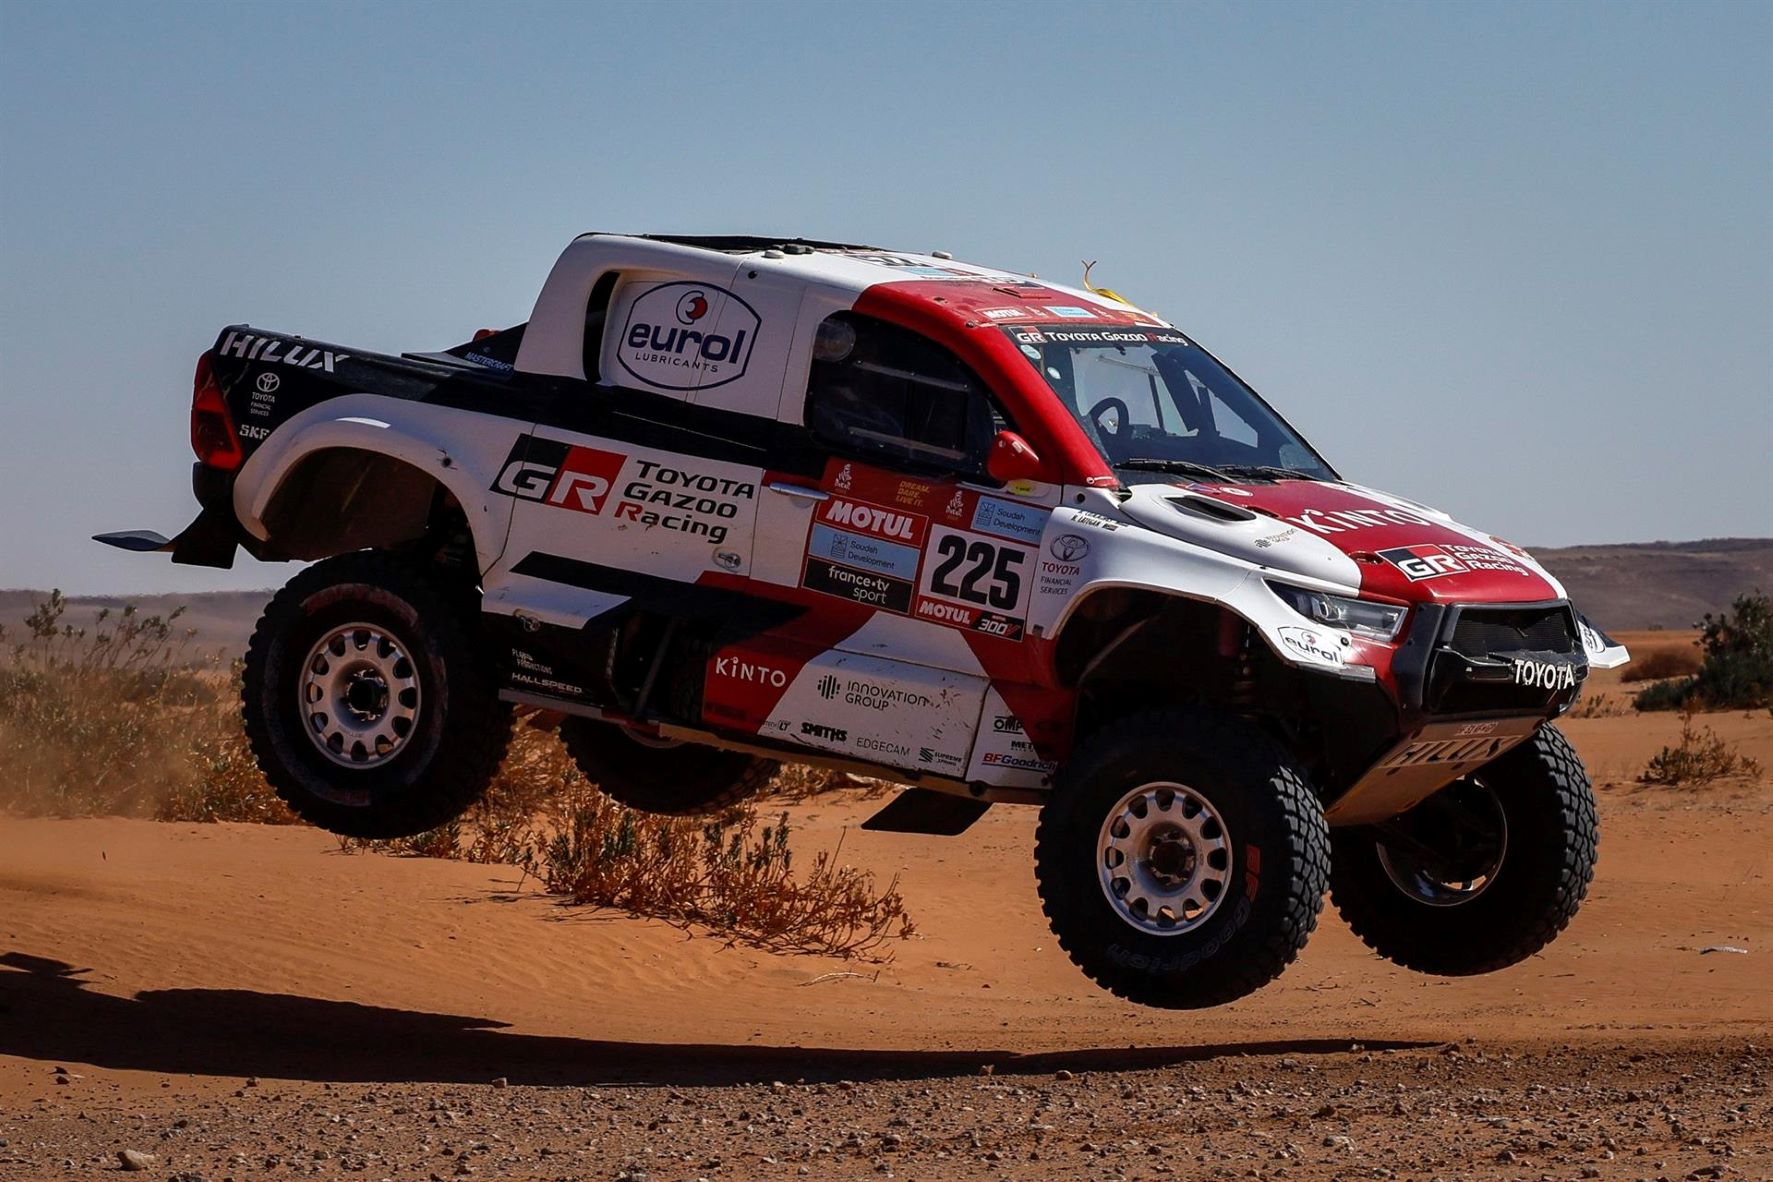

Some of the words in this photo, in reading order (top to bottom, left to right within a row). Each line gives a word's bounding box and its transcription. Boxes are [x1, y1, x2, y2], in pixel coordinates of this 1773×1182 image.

[628, 323, 746, 364] eurol
[1016, 332, 1044, 343] GR
[1045, 332, 1101, 342] TOYOTA
[1102, 333, 1148, 343] GAZOO
[1148, 333, 1188, 346] Racing
[221, 331, 350, 373] HILUX
[635, 352, 719, 373] LUBRICANTS
[252, 392, 276, 403] TOYOTA
[239, 423, 271, 440] SKF
[498, 460, 609, 512] GR
[636, 460, 754, 500] TOYOTA
[624, 482, 737, 519] GAZOO
[614, 501, 727, 545] Racing
[825, 500, 914, 539] MOTUL
[996, 509, 1025, 521] Soudah
[994, 518, 1041, 535] Development
[850, 541, 878, 555] Soudah
[847, 553, 895, 570] Development
[1042, 561, 1080, 576] TOYOTA
[1397, 556, 1463, 577] GR
[1466, 560, 1529, 576] Racing
[930, 534, 1026, 611] 225
[1040, 576, 1072, 586] FINANCIAL
[853, 586, 888, 604] sport
[1040, 586, 1068, 595] SERVICES
[919, 600, 971, 624] MOTUL
[1285, 637, 1339, 662] eurol
[512, 672, 583, 694] HALLSPEED
[1514, 658, 1576, 690] TOYOTA
[845, 692, 890, 711] GROUP
[801, 721, 848, 742] SMITHS
[994, 718, 1024, 731] OMP
[856, 737, 911, 757] EDGECAM
[982, 753, 1058, 770] BFGoodrich
